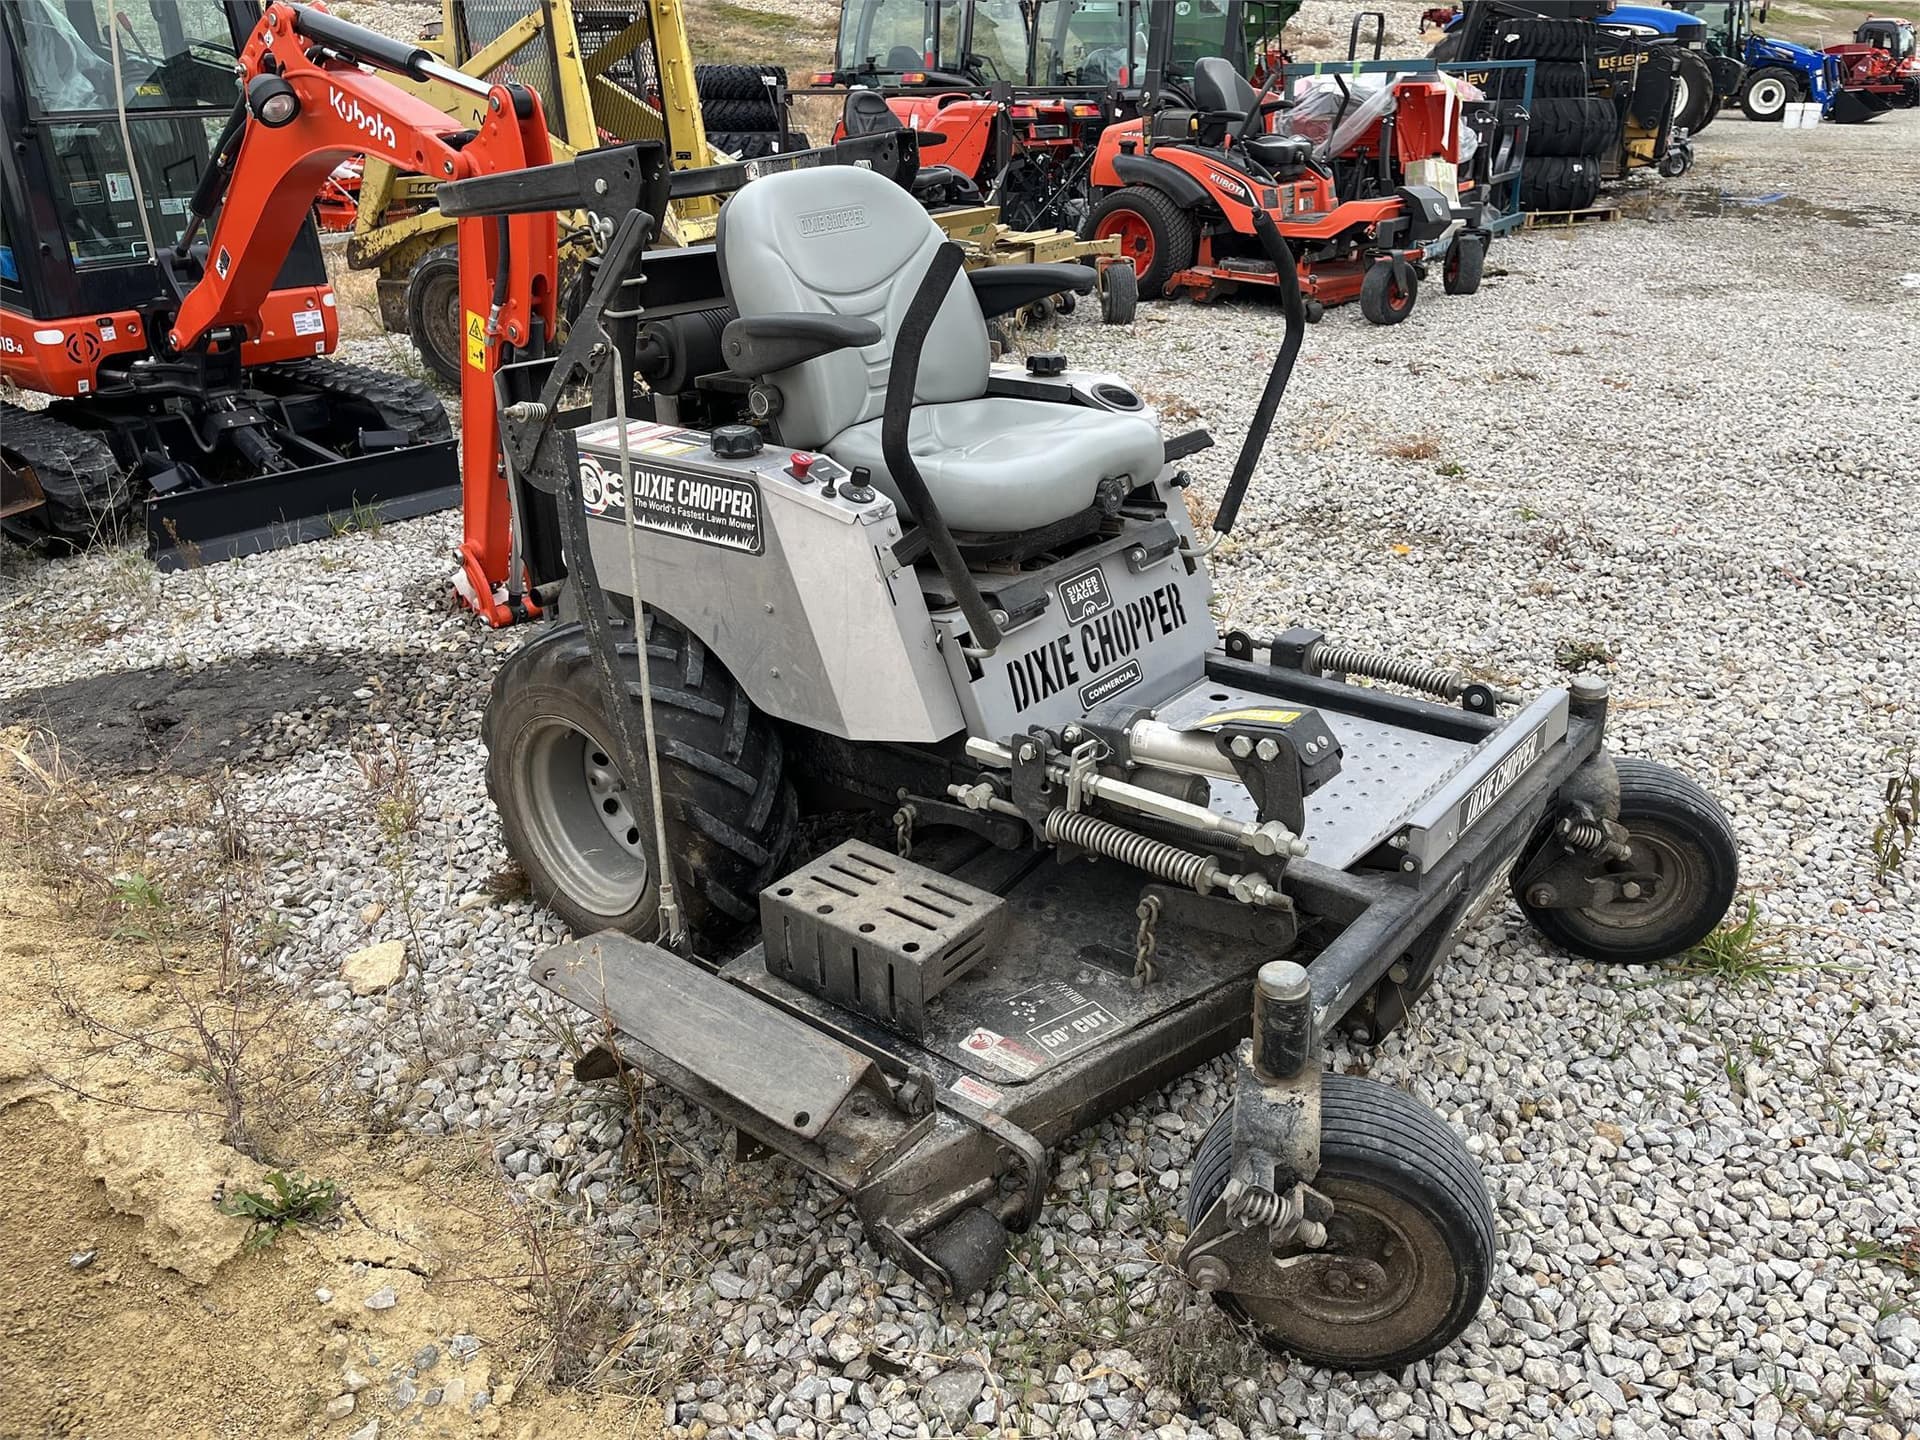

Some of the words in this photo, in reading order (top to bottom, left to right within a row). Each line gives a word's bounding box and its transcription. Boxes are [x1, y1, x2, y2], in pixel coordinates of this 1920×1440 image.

[329, 86, 396, 149] Kubota
[1210, 172, 1246, 198] KUBOTA
[800, 216, 825, 234] DIXIE
[825, 208, 865, 230] CHOPPER
[0, 336, 23, 354] 18-4
[634, 470, 675, 502] DIXIE
[677, 479, 753, 519] CHOPPER
[633, 496, 648, 508] The
[649, 500, 676, 515] World's
[677, 506, 705, 521] Fastest
[706, 513, 727, 525] Lawn
[728, 517, 756, 532] Mower
[1066, 576, 1098, 597] SILVER
[1070, 584, 1101, 605] EAGLE
[1085, 605, 1097, 617] HP
[1006, 633, 1080, 714] DIXIE
[1080, 582, 1187, 674] CHOPPER
[1088, 669, 1137, 700] COMMERCIAL
[1466, 771, 1496, 826] DIXIE
[1494, 732, 1538, 797] CHOPPER
[1071, 1010, 1109, 1033] CUT
